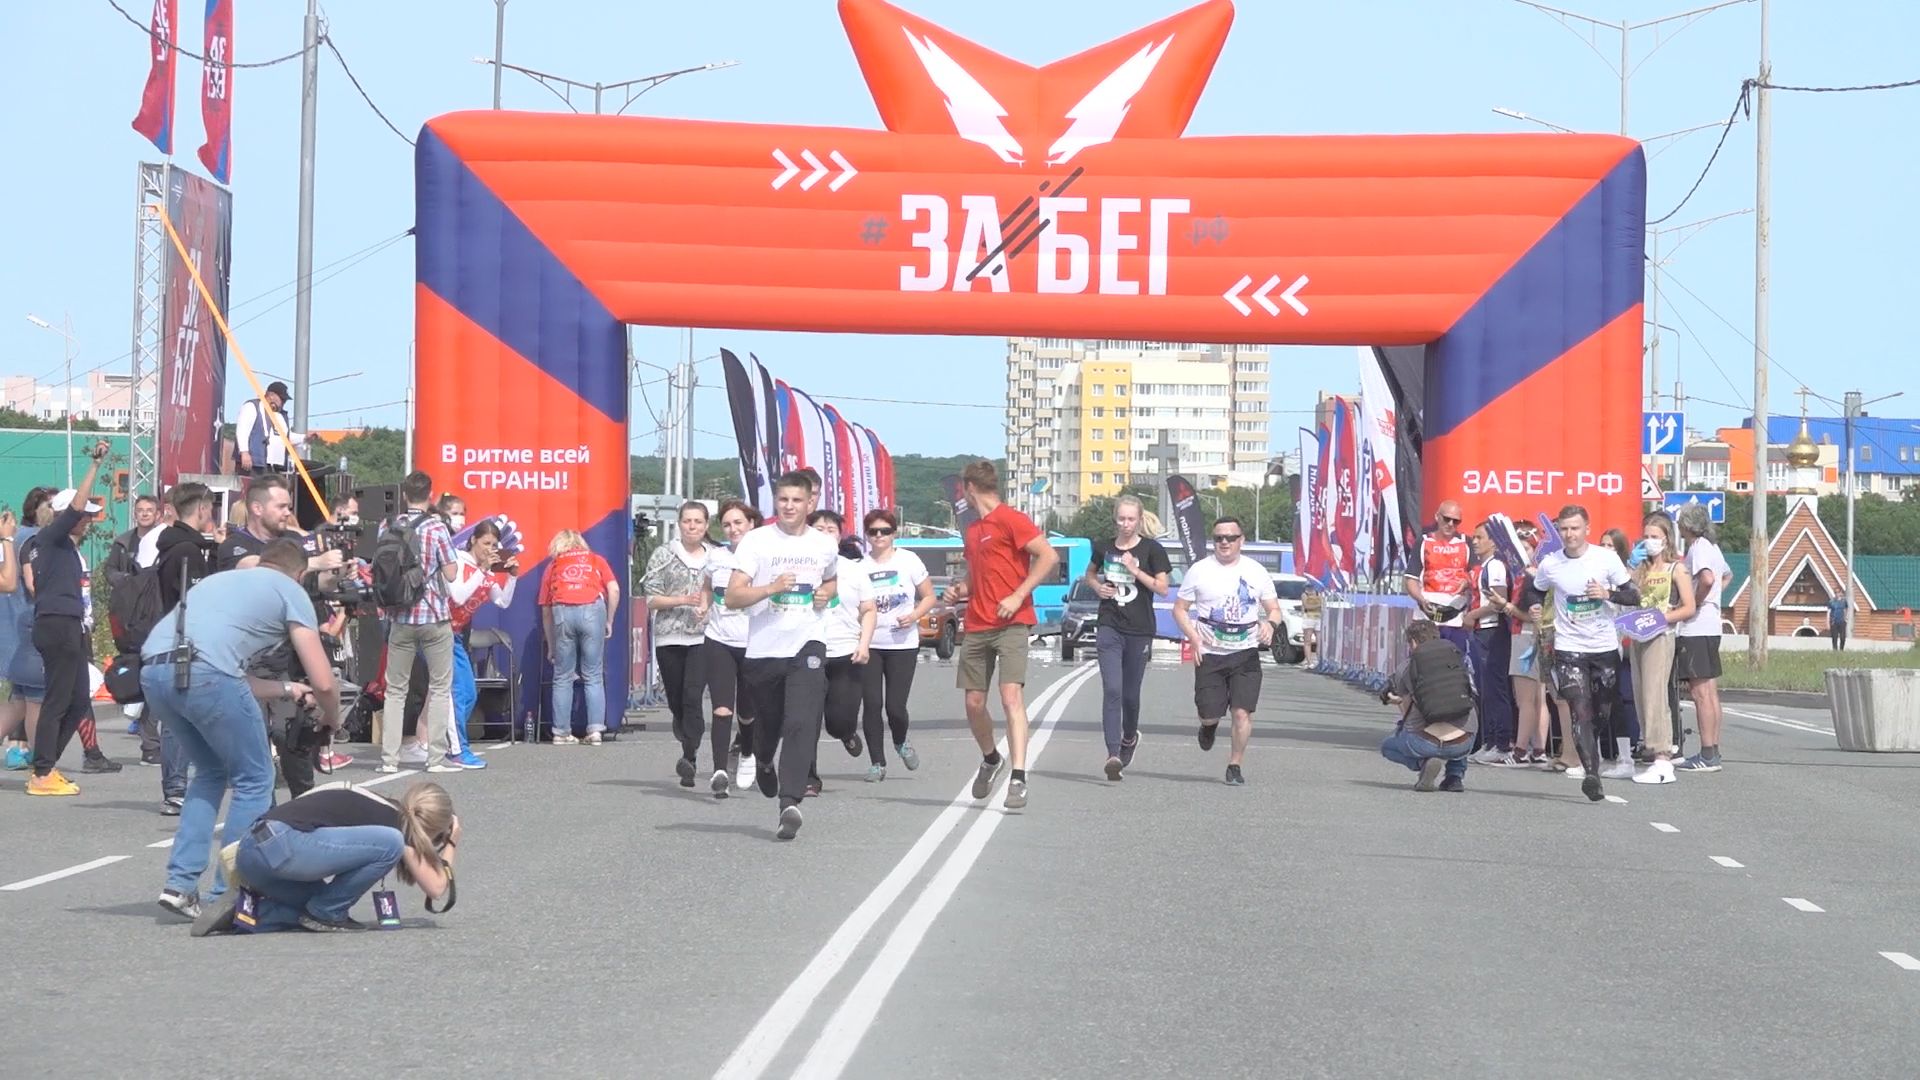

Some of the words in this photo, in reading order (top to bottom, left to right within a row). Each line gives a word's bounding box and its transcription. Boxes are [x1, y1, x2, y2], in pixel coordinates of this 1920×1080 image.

[441, 444, 457, 463] В
[463, 448, 533, 466] ритме
[539, 445, 590, 464] всей
[462, 470, 569, 490] СТРАНЫ!
[1462, 469, 1623, 496] ЗАБЕГ.РФ
